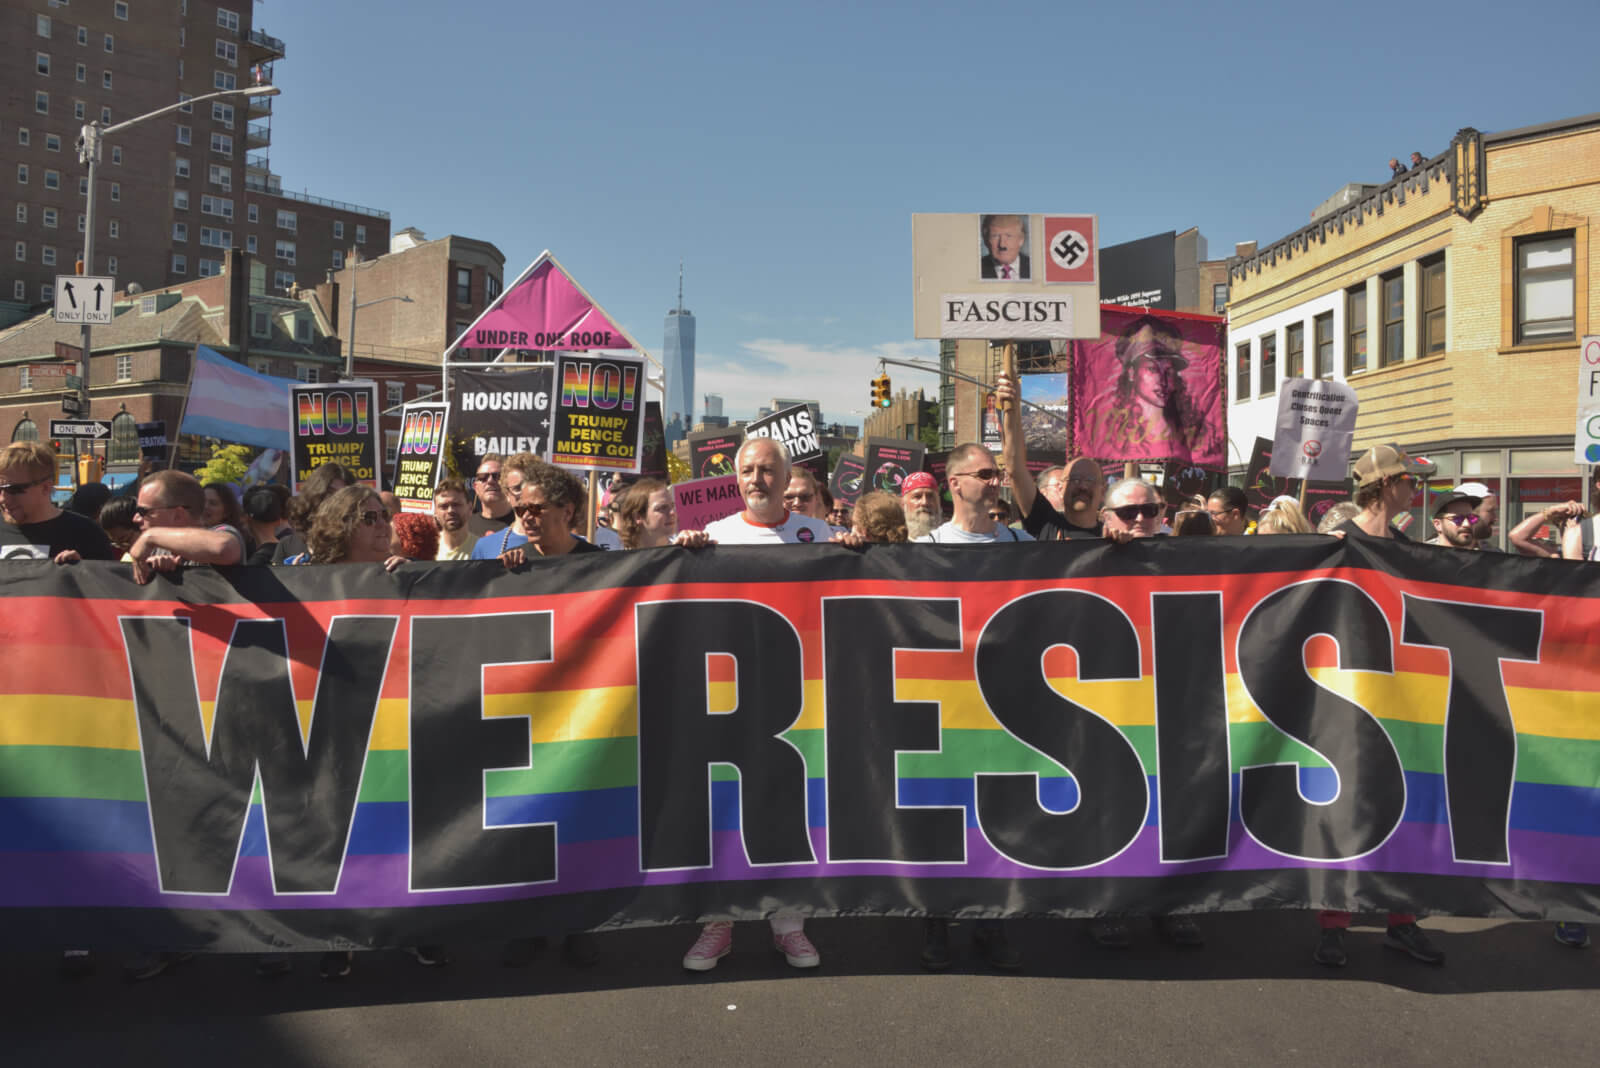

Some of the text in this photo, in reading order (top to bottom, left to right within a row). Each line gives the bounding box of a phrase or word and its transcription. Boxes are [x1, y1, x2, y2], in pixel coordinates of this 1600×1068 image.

[59, 311, 81, 320] ONLY
[86, 312, 109, 321] ONLY
[946, 301, 1068, 322] FASCIST
[476, 330, 612, 347] UNDER ONE ROOF
[561, 361, 638, 411] NO!
[462, 392, 548, 411] HOUSING
[1292, 389, 1346, 402] Gentrification
[297, 391, 369, 436] NO!
[1291, 403, 1342, 416] Closes Queer
[568, 413, 628, 430] TRUMP/
[1299, 416, 1329, 428] Spaces
[59, 425, 103, 434] ONE WAY
[401, 410, 444, 455] NO!
[570, 429, 623, 443] PENCE
[306, 442, 364, 455] TRUMP/
[474, 436, 540, 456] BAILEY
[557, 440, 602, 455] MUST
[606, 445, 634, 457] GO!
[787, 433, 820, 458] TION
[311, 456, 361, 467] PENCE
[401, 460, 433, 474] TRUMP/
[400, 473, 428, 486] PENCE
[395, 486, 434, 500] MUST GO!
[680, 489, 703, 506] WE
[117, 577, 1544, 896] WE RESIST
